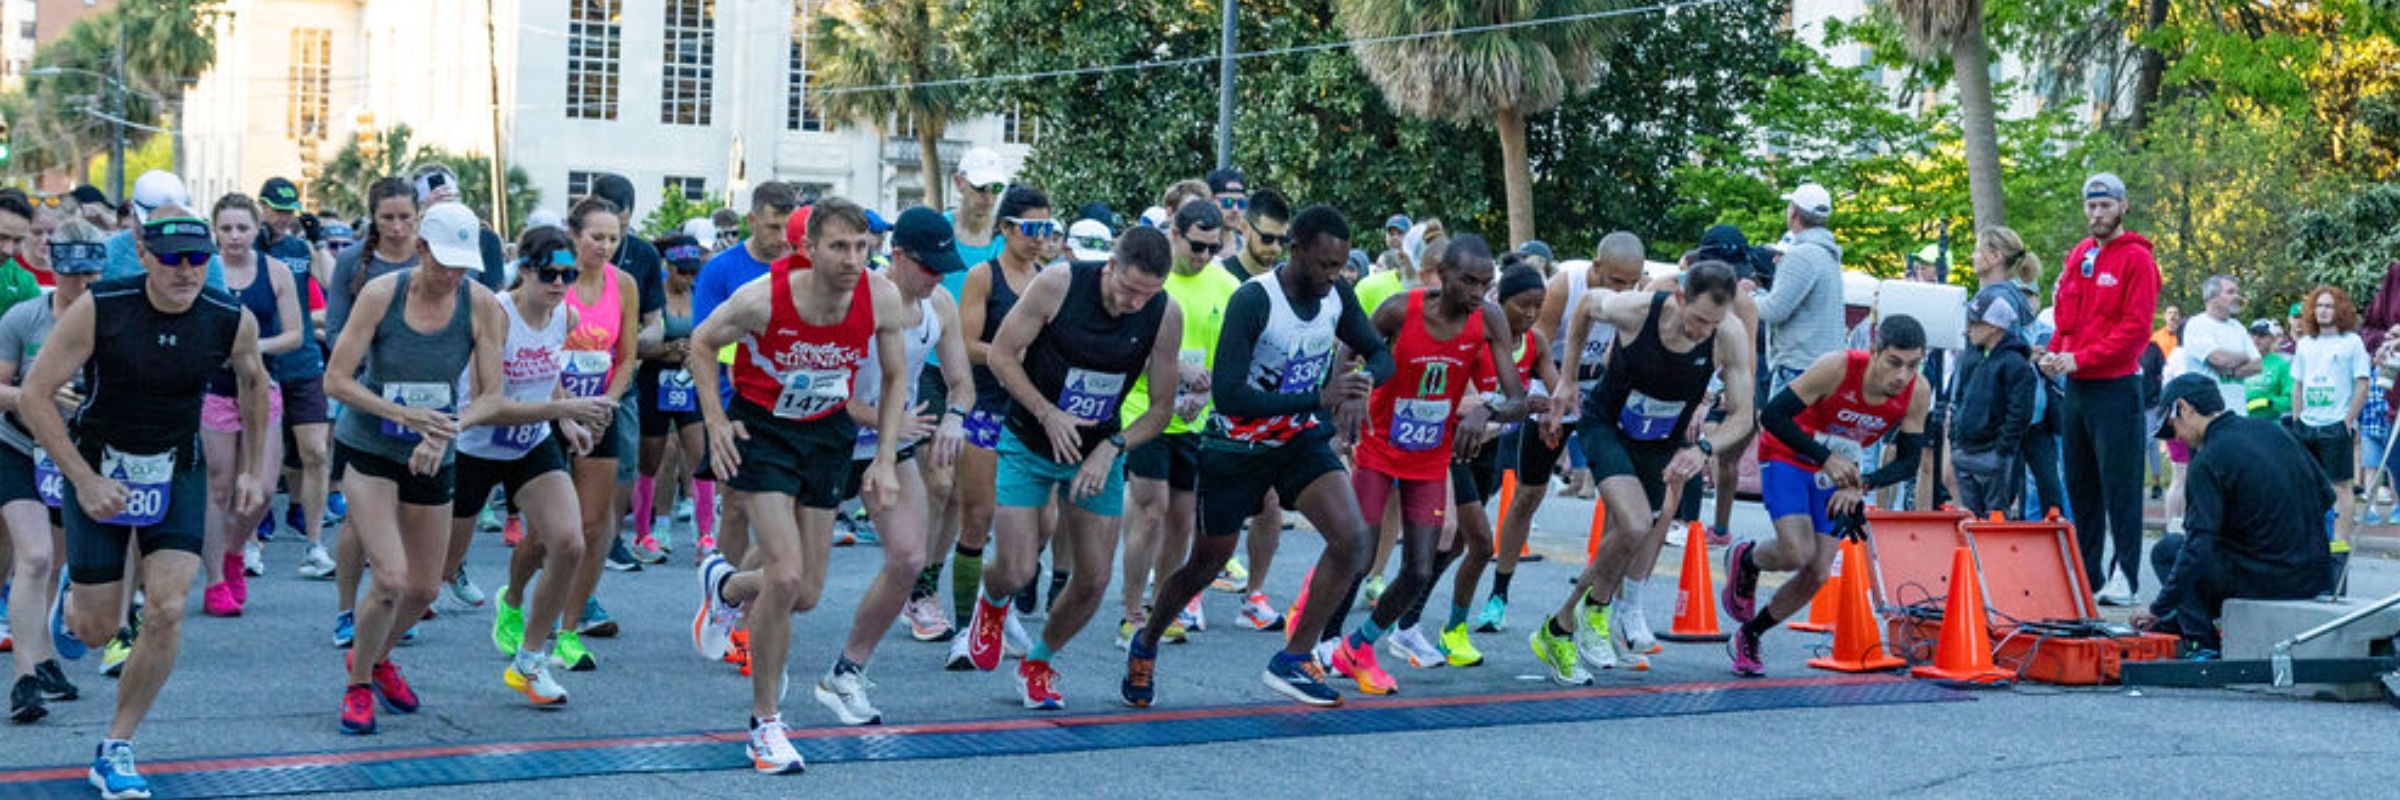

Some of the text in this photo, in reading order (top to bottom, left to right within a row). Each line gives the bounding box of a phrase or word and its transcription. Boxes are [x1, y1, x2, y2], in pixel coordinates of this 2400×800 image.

[566, 377, 602, 397] 217
[669, 391, 687, 406] 99
[1067, 396, 1107, 416] 291
[1398, 423, 1438, 443] 242
[1642, 419, 1652, 434] 1
[119, 489, 162, 516] 80
